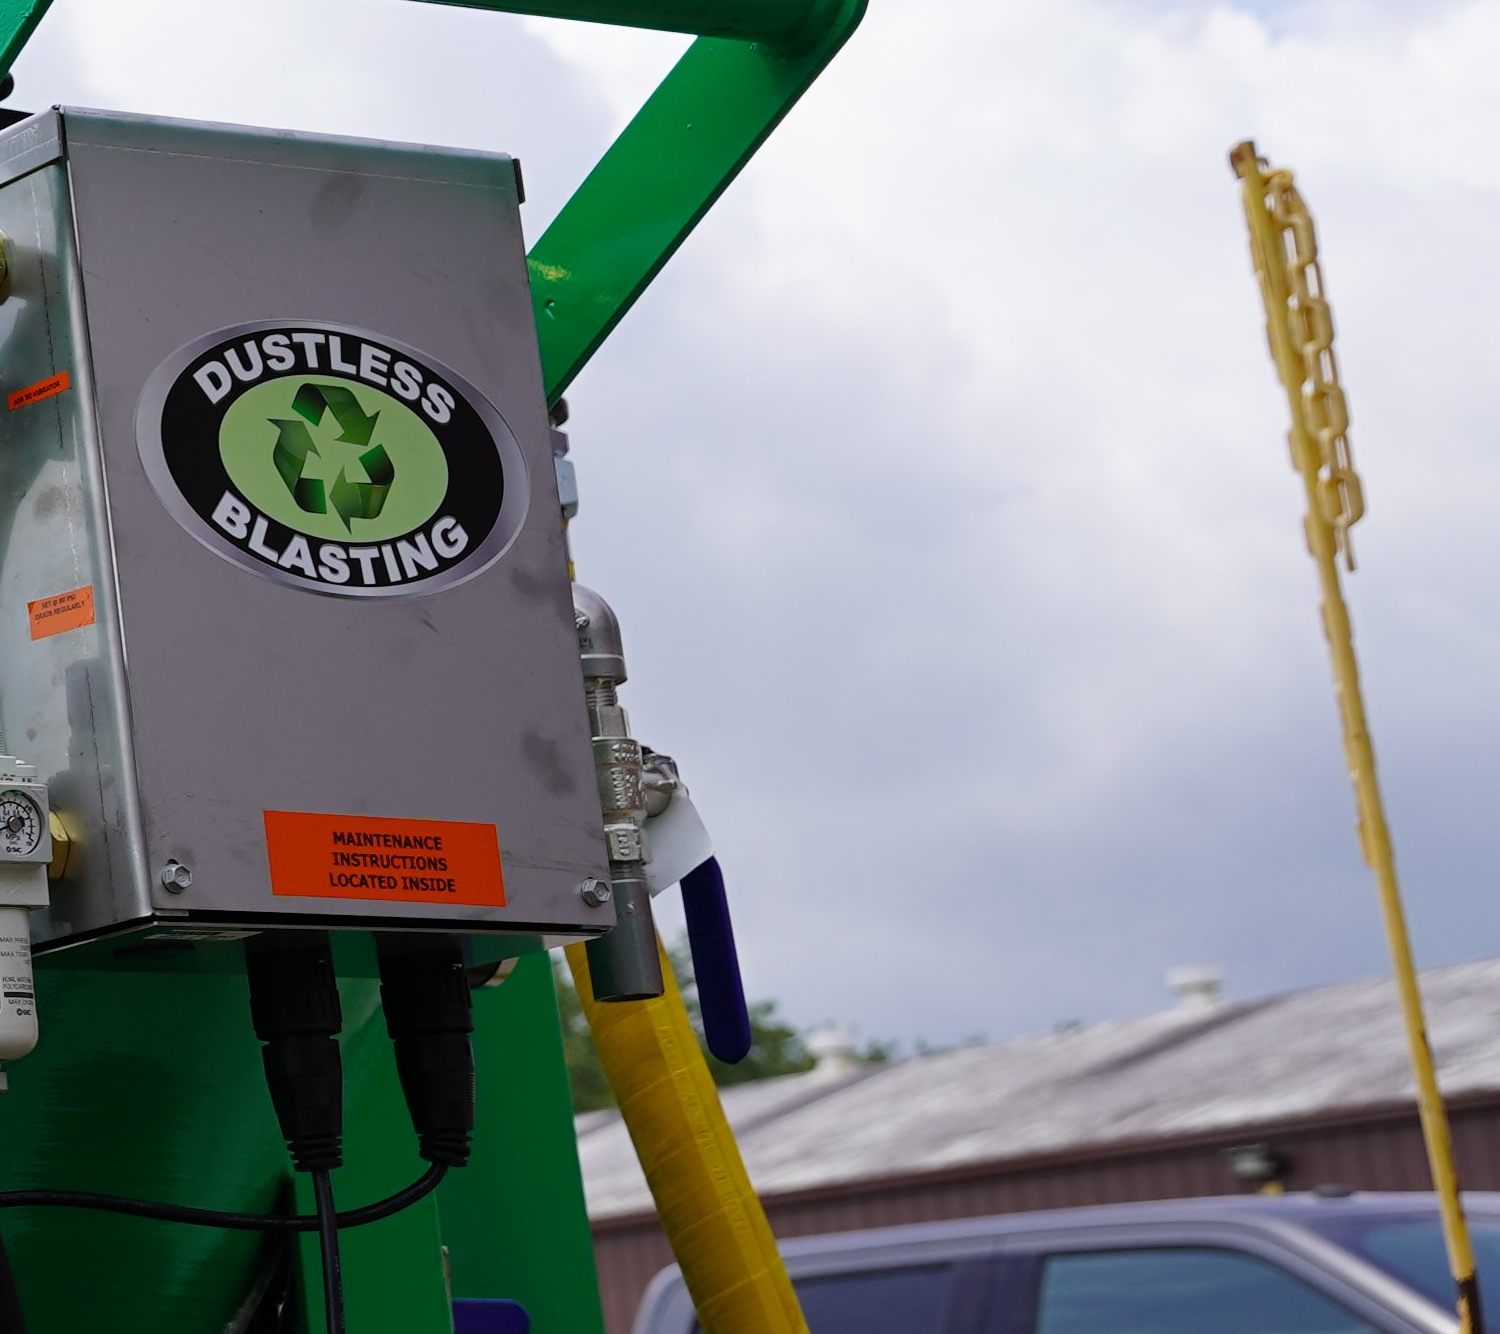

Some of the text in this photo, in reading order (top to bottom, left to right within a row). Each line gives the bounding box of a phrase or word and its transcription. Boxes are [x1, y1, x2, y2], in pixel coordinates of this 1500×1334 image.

[192, 331, 456, 426] DUSTLESS
[211, 489, 470, 586] BLASTING
[332, 831, 442, 851] MAINTENANCE
[332, 851, 448, 871] INSTRUCTIONS
[329, 872, 456, 893] LOCATED INSIDE
